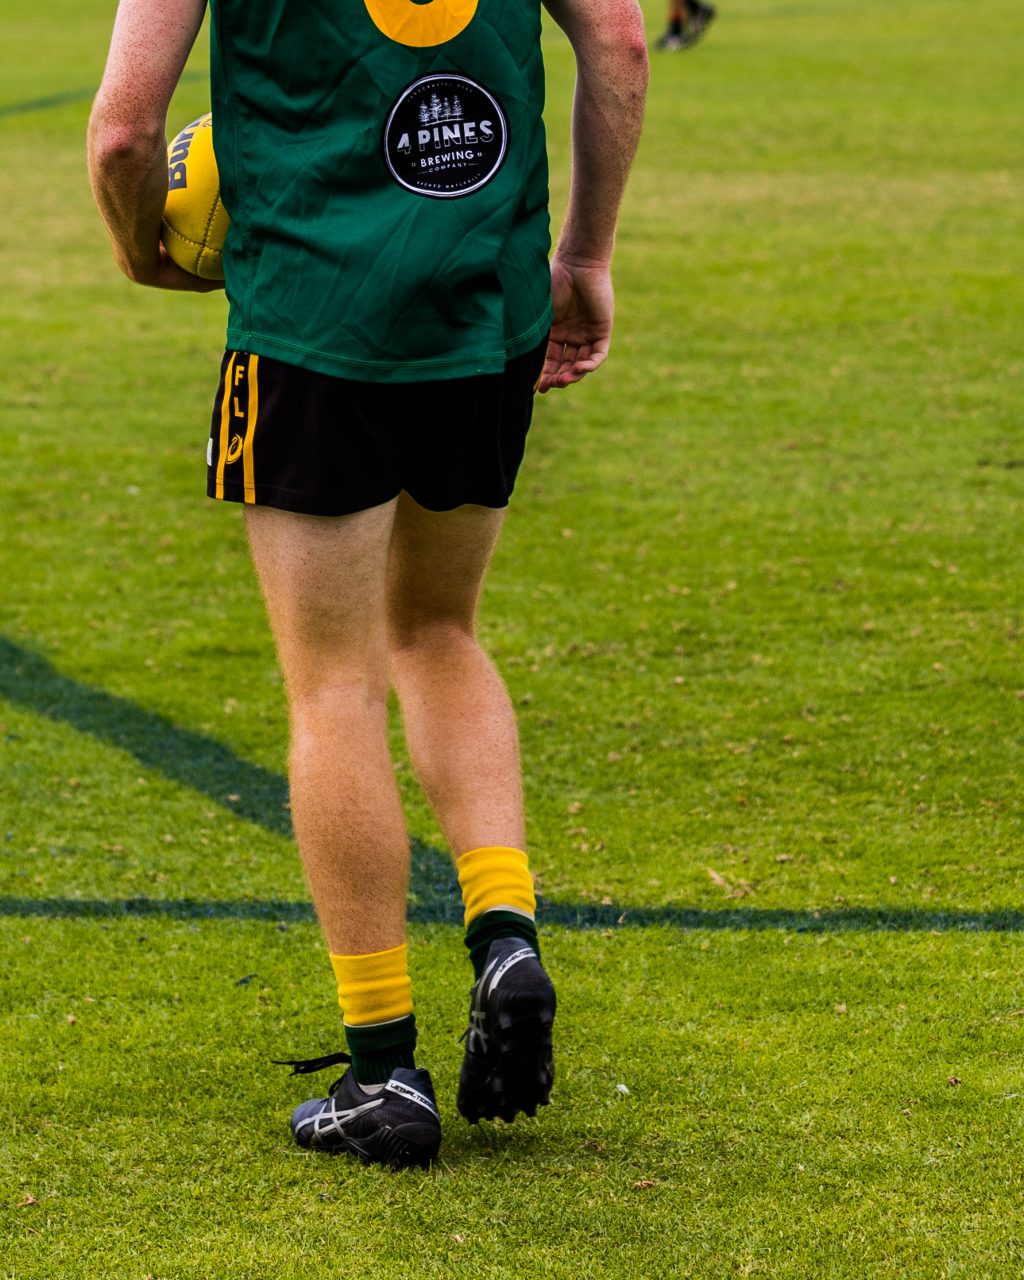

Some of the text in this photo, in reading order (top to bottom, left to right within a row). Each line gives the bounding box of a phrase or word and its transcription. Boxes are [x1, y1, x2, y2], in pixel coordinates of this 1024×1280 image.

[397, 120, 494, 155] 4 PINES
[169, 121, 201, 190] Bur
[420, 150, 474, 168] BREWING
[428, 162, 467, 173] COMPANY
